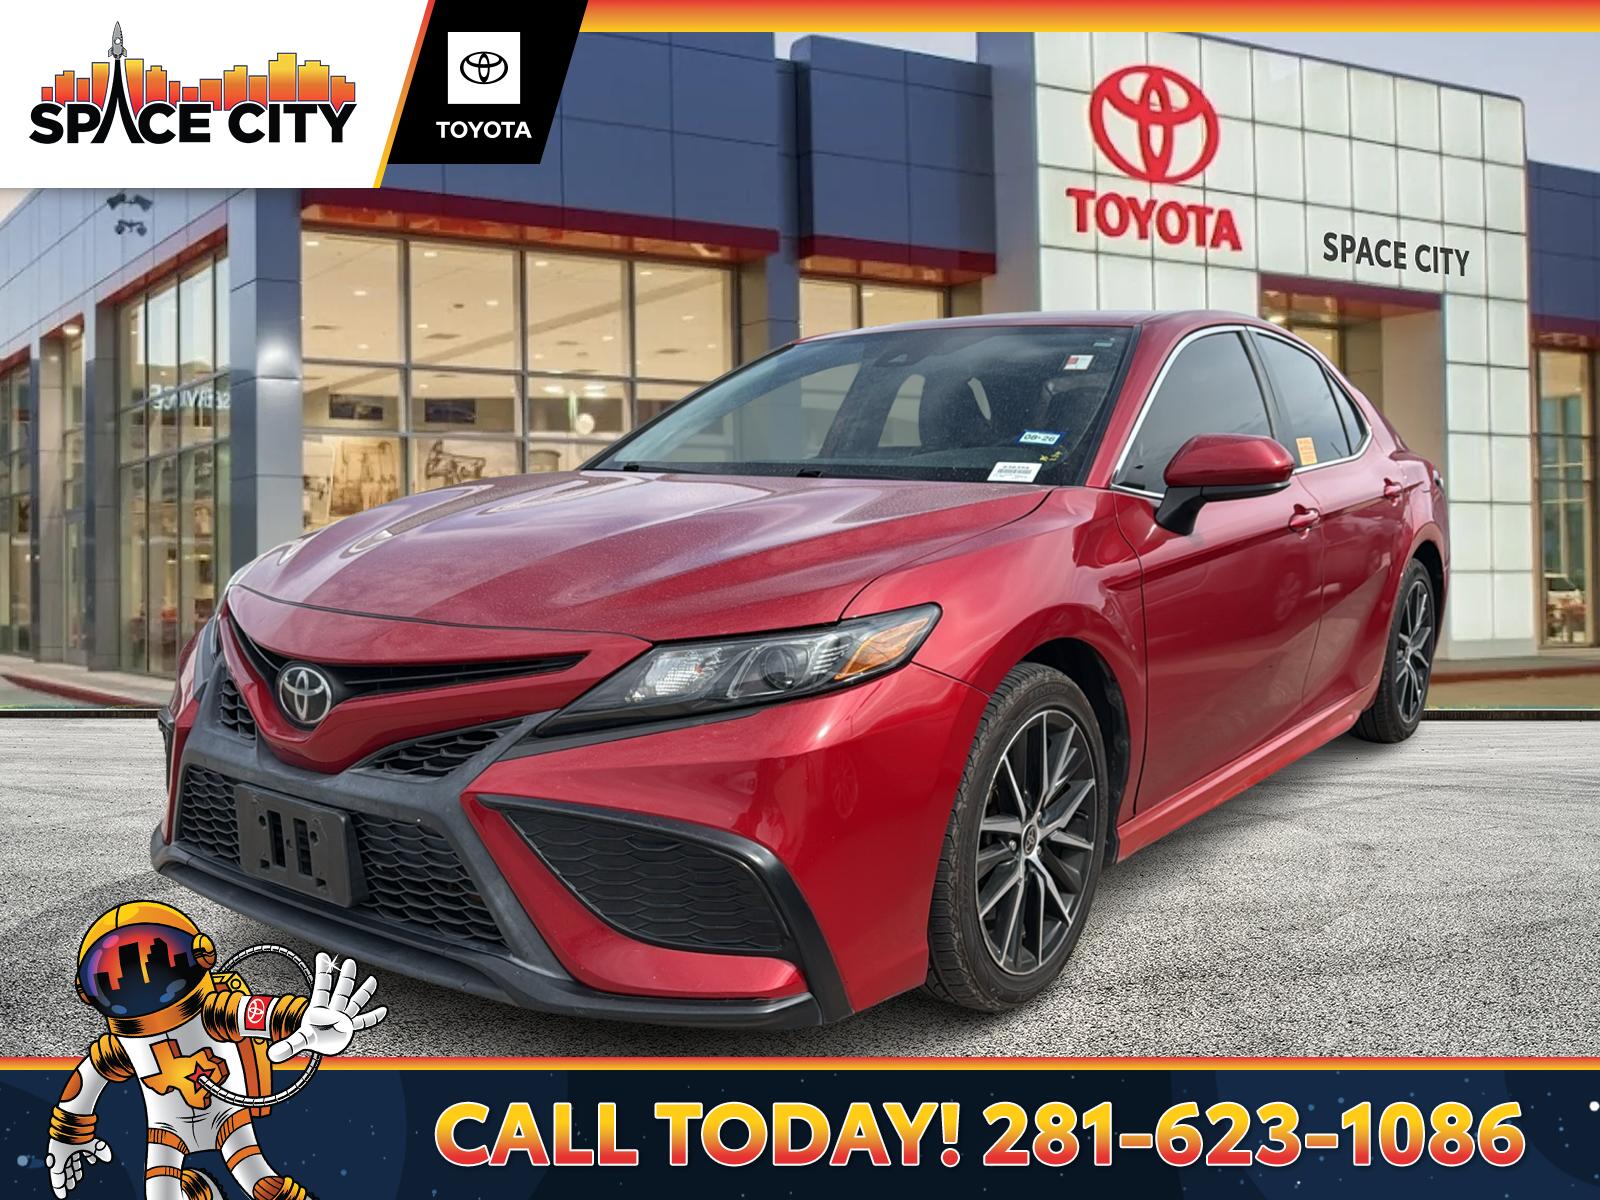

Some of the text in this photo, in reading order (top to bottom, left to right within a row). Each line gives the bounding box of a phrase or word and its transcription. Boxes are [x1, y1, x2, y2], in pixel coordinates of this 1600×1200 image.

[1066, 188, 1242, 251] TOYOTA
[1323, 232, 1470, 277] SPACE CITY
